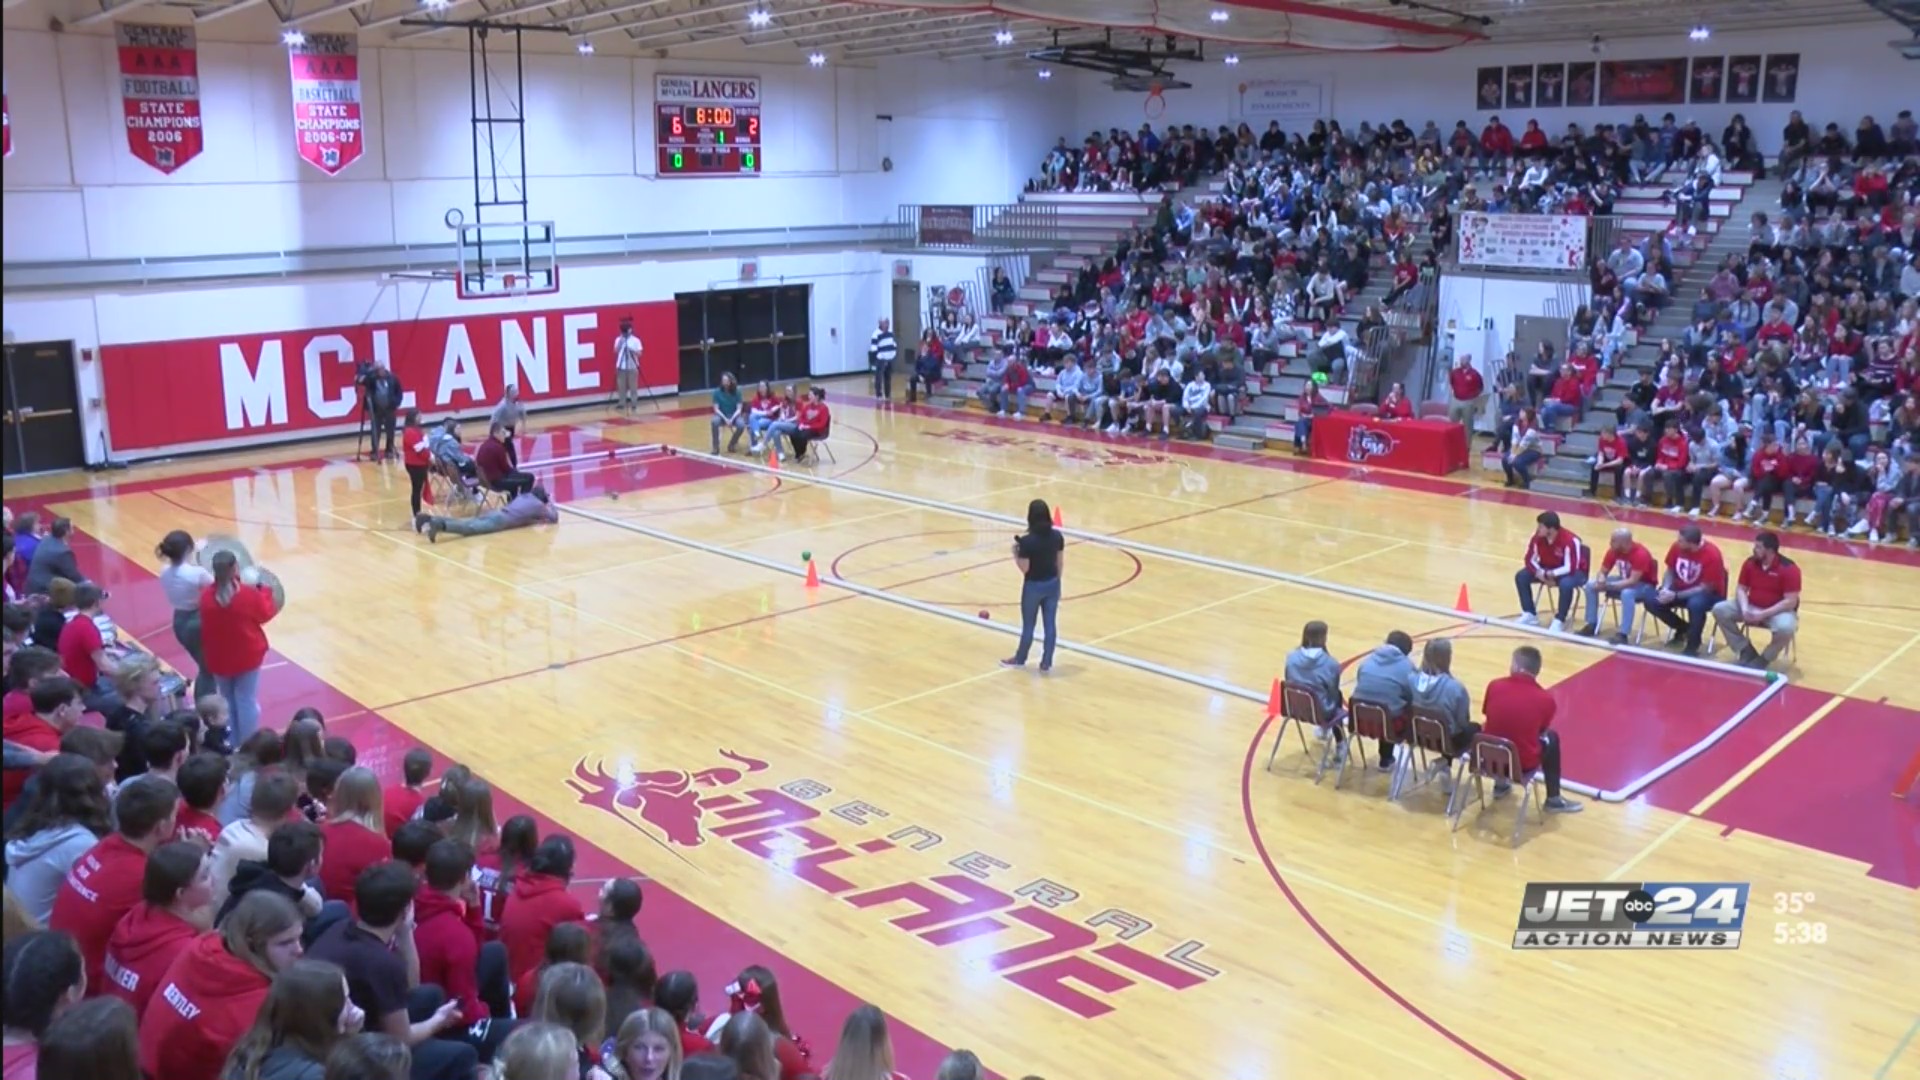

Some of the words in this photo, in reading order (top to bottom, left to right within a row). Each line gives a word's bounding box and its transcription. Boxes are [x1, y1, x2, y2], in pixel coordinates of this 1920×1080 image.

[125, 79, 196, 95] FOOTBALL
[693, 80, 756, 99] LANCERS
[139, 102, 185, 114] STATE
[308, 105, 348, 117] STATE
[696, 108, 731, 124] 8:00
[127, 116, 201, 129] CHAMPIONS
[297, 119, 360, 130] CHAMPIONS
[672, 116, 682, 135] 6
[749, 118, 758, 135] 2
[148, 131, 182, 143] 2006
[304, 131, 354, 143] 2006-07
[719, 130, 725, 145] 1
[674, 152, 683, 168] 0
[745, 152, 754, 168] 0
[779, 778, 1221, 977] GENERAL
